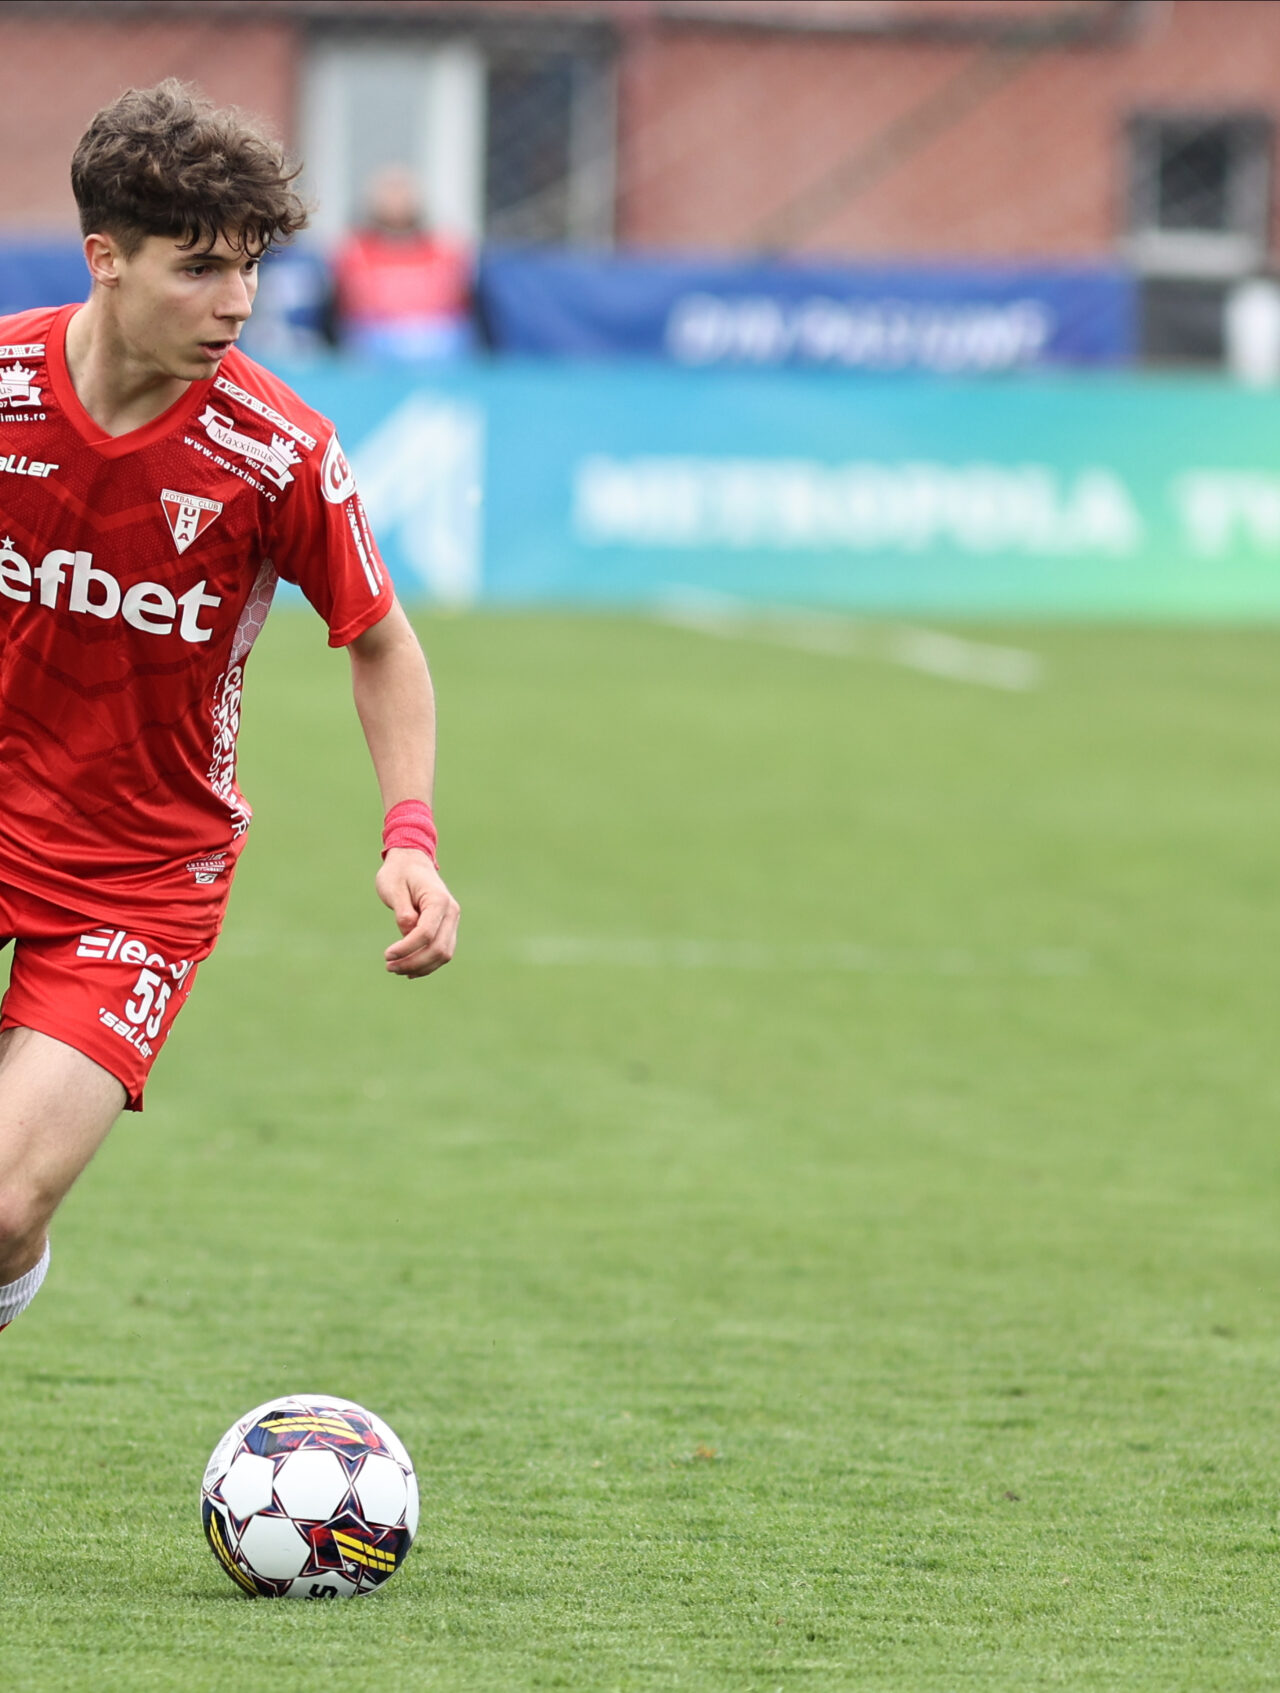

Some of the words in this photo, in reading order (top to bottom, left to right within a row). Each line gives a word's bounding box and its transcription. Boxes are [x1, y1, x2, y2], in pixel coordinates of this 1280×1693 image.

[214, 428, 274, 463] Maxximus
[164, 492, 194, 506] FOTBAL
[198, 500, 219, 511] CLUB
[125, 967, 172, 1039] 55
